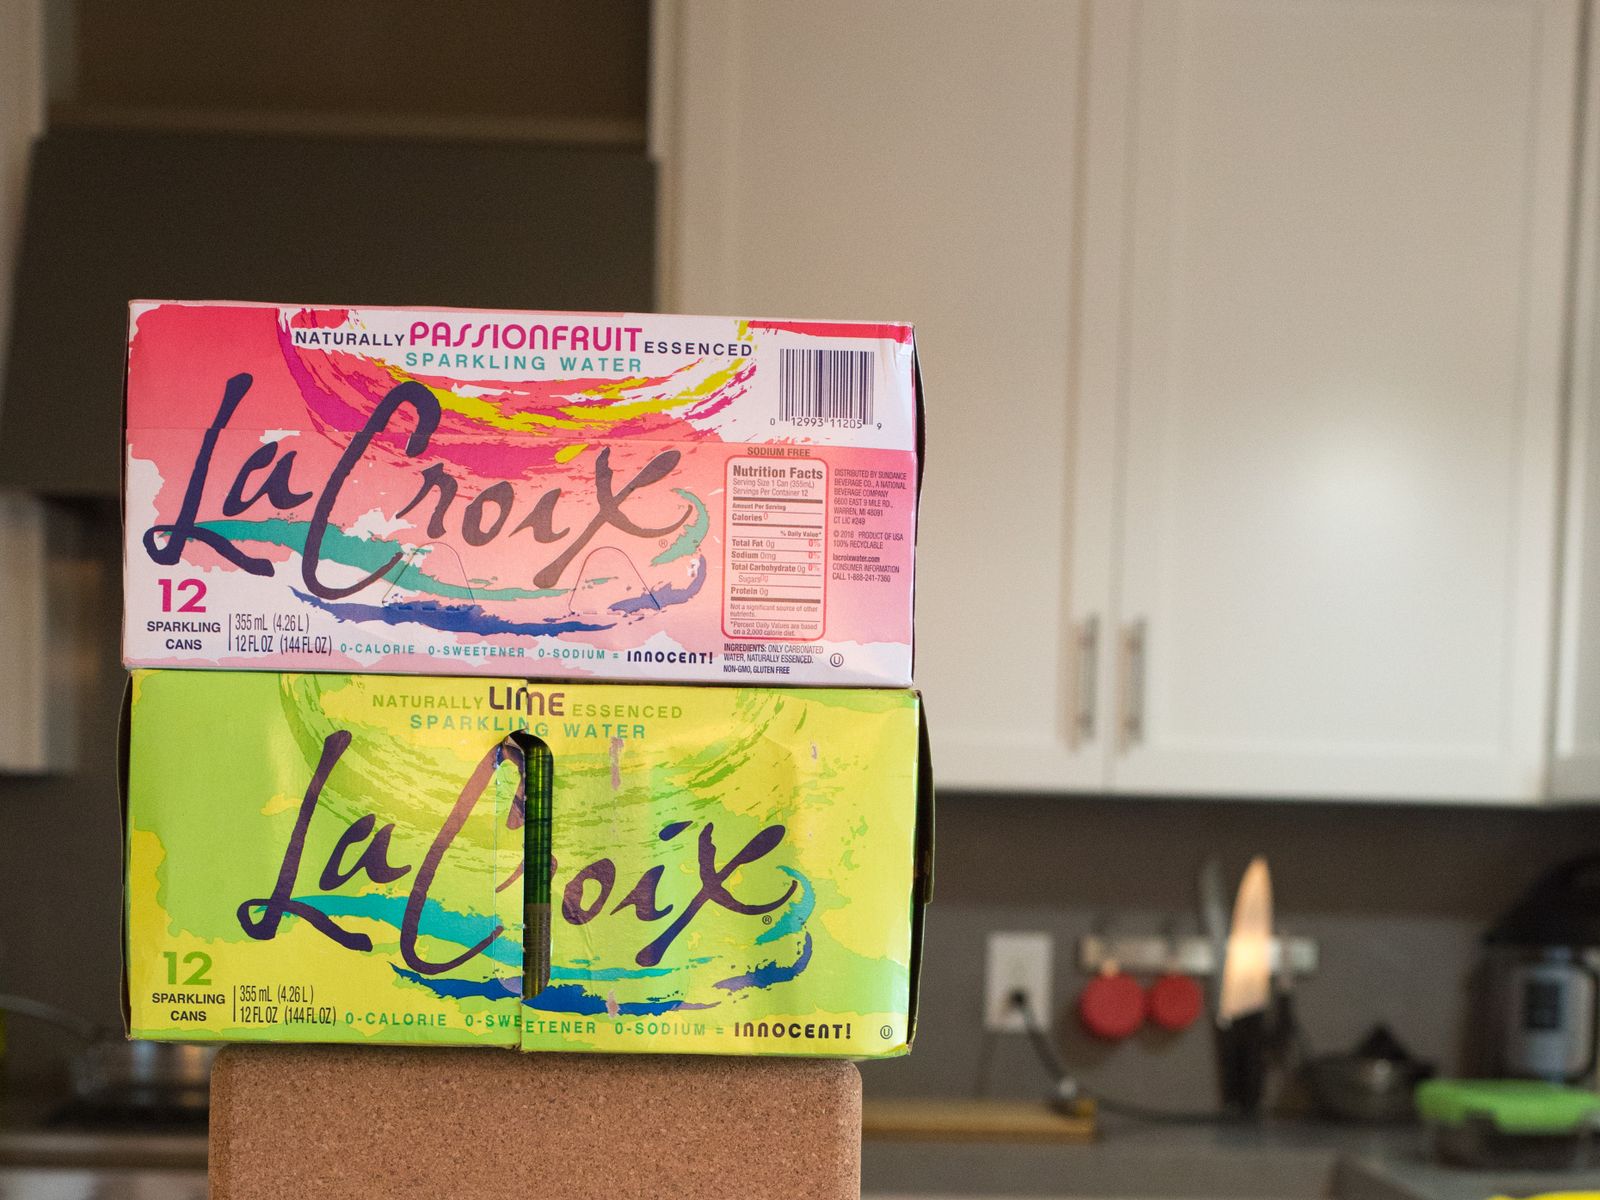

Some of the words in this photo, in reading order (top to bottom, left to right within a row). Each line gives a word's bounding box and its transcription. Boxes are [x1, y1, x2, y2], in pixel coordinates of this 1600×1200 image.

[294, 331, 406, 347] NATURALLY
[409, 321, 643, 352] PASSIONFRUIT
[643, 340, 752, 356] ESSENCED
[405, 352, 546, 371] SPARKLING
[559, 356, 642, 373] WATER
[791, 417, 824, 427] 12993
[830, 419, 863, 429] 11205
[747, 446, 785, 456] SODIUM
[787, 448, 811, 457] FREE
[733, 465, 786, 478] Nutrition
[790, 467, 823, 480] Facts
[834, 468, 869, 478] DISTRIBUTED
[878, 471, 907, 480] SUNDANCE
[733, 478, 755, 487] Serving
[757, 479, 770, 487] Size
[777, 480, 788, 488] Can
[834, 478, 862, 487] BEVERAGE
[880, 481, 906, 490] NATIONAL
[733, 487, 761, 496] Servings
[772, 488, 799, 497] Container
[801, 489, 808, 497] 12
[834, 487, 861, 496] BEVERAGE
[862, 489, 888, 497] COMPANY
[732, 513, 762, 521] Calories
[858, 531, 883, 540] PRODUCT
[893, 533, 904, 541] USA
[732, 539, 750, 547] Total
[766, 540, 775, 549] 0g
[850, 541, 884, 549] RECYCLABLE
[731, 551, 759, 559] Sodium
[731, 563, 748, 571] Total
[750, 563, 796, 572] Carbohydrate
[797, 565, 806, 573] 0g
[833, 563, 863, 572] CONSUMER
[864, 564, 900, 573] INFORMATION
[833, 572, 846, 580] CALL
[157, 578, 208, 613] 12
[731, 587, 758, 595] Protein
[759, 588, 769, 596] 0g
[147, 620, 221, 633] SPARKLING
[235, 614, 252, 631] 355
[254, 615, 268, 631] mL
[165, 638, 202, 650] CANS
[724, 643, 767, 652] INGREDIENTS:
[768, 644, 784, 653] ONLY
[785, 645, 824, 654] CARBONATED
[340, 643, 415, 655] 0-CALORIE
[428, 645, 525, 657] 0-SWEETENER
[538, 648, 605, 660] 0-SODIUM
[627, 650, 713, 665] INNOCENT!
[724, 653, 746, 662] WATER,
[747, 654, 779, 663] NATURALLY
[781, 655, 814, 664] ESSENCED.
[723, 665, 752, 674] NON-GMO,
[753, 666, 775, 674] GLUTEN
[776, 666, 790, 674] FREE
[372, 694, 484, 710] NATURALLY
[489, 686, 565, 716] LIME
[572, 704, 683, 719] ESSENCED
[410, 714, 549, 737] SPARKLING
[564, 723, 646, 739] WATER
[163, 951, 212, 986] 12
[152, 993, 225, 1005] SPARKLING
[240, 985, 257, 1002] 355
[259, 986, 272, 1002] mL
[170, 1010, 207, 1022] CANS
[345, 1012, 447, 1027] 0-CALORIE
[615, 1022, 705, 1035] 0-SODIUM
[734, 1022, 851, 1040] INNOCENT!
